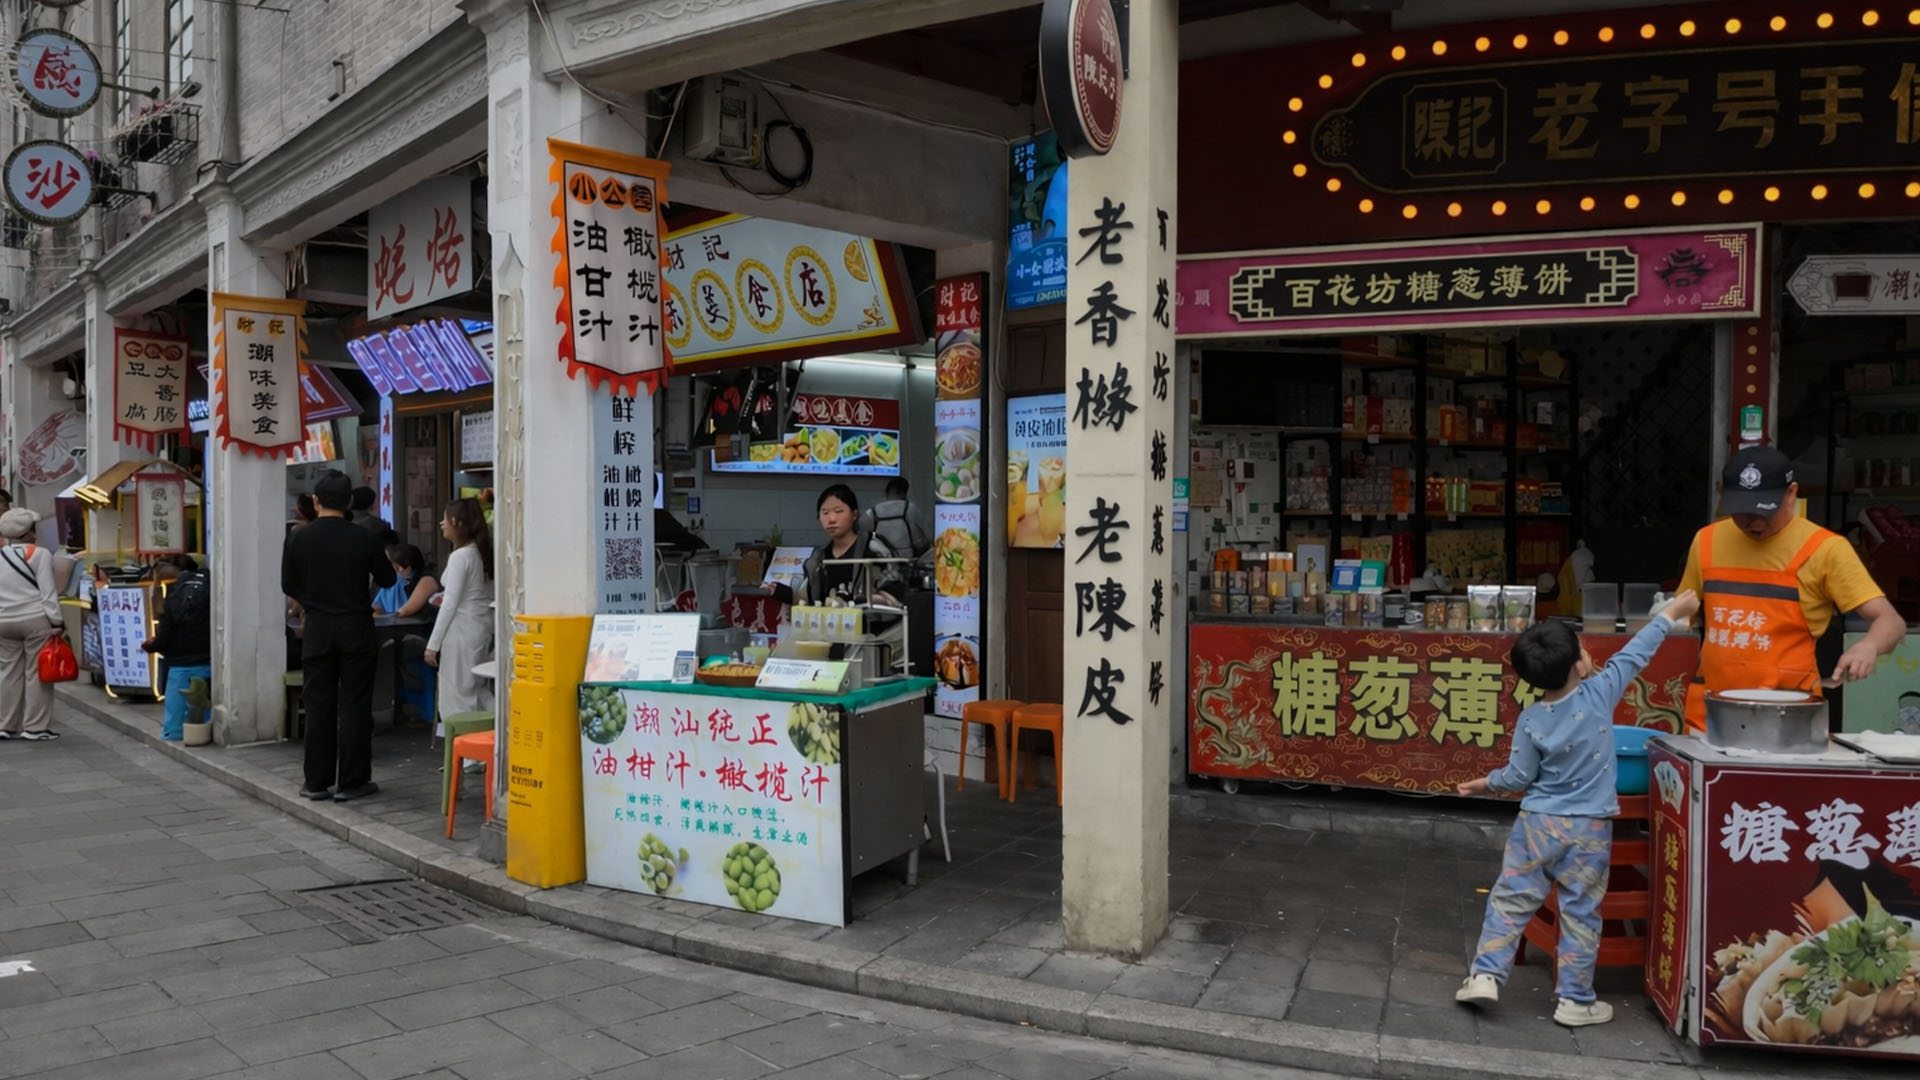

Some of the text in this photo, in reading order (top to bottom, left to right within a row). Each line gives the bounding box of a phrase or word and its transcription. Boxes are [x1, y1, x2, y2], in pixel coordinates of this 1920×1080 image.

[25, 158, 81, 210] 沙
[573, 219, 614, 342] 油甘汁
[623, 226, 660, 346] 橄榄汁
[1284, 262, 1573, 310] 百花坊糖葱薄饼
[1075, 496, 1136, 726] 老陳皮
[632, 702, 779, 746] 潮汕纯正
[1272, 651, 1544, 748] 糖葱薄
